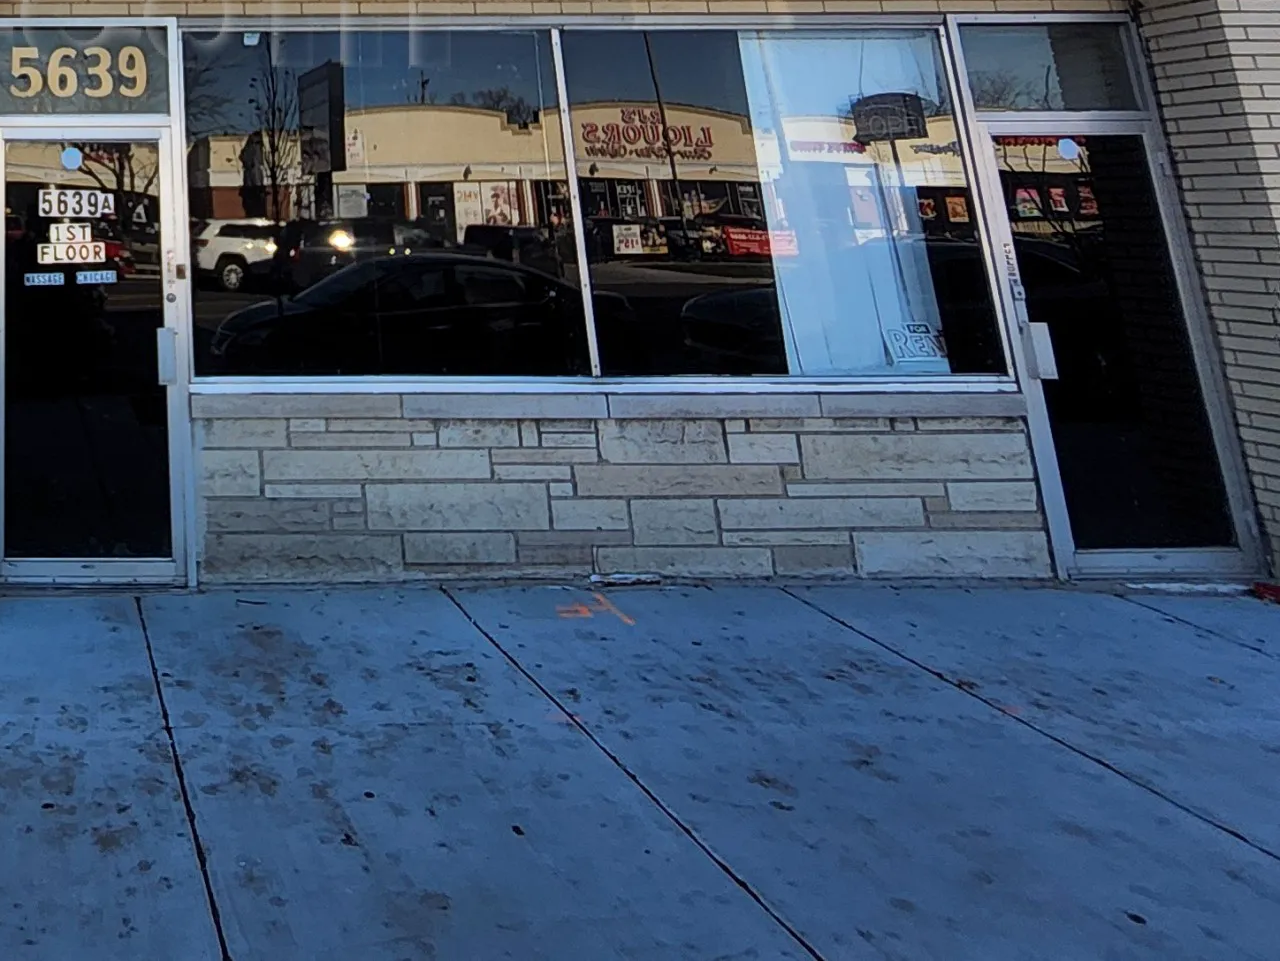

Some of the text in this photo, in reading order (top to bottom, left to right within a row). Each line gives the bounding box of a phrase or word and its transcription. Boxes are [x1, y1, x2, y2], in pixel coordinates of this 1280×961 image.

[9, 45, 149, 100] 5639
[40, 191, 113, 216] 5639A
[55, 225, 91, 242] 1ST
[40, 244, 103, 262] FLOOR
[908, 325, 927, 333] FOR
[887, 328, 948, 359] REN
